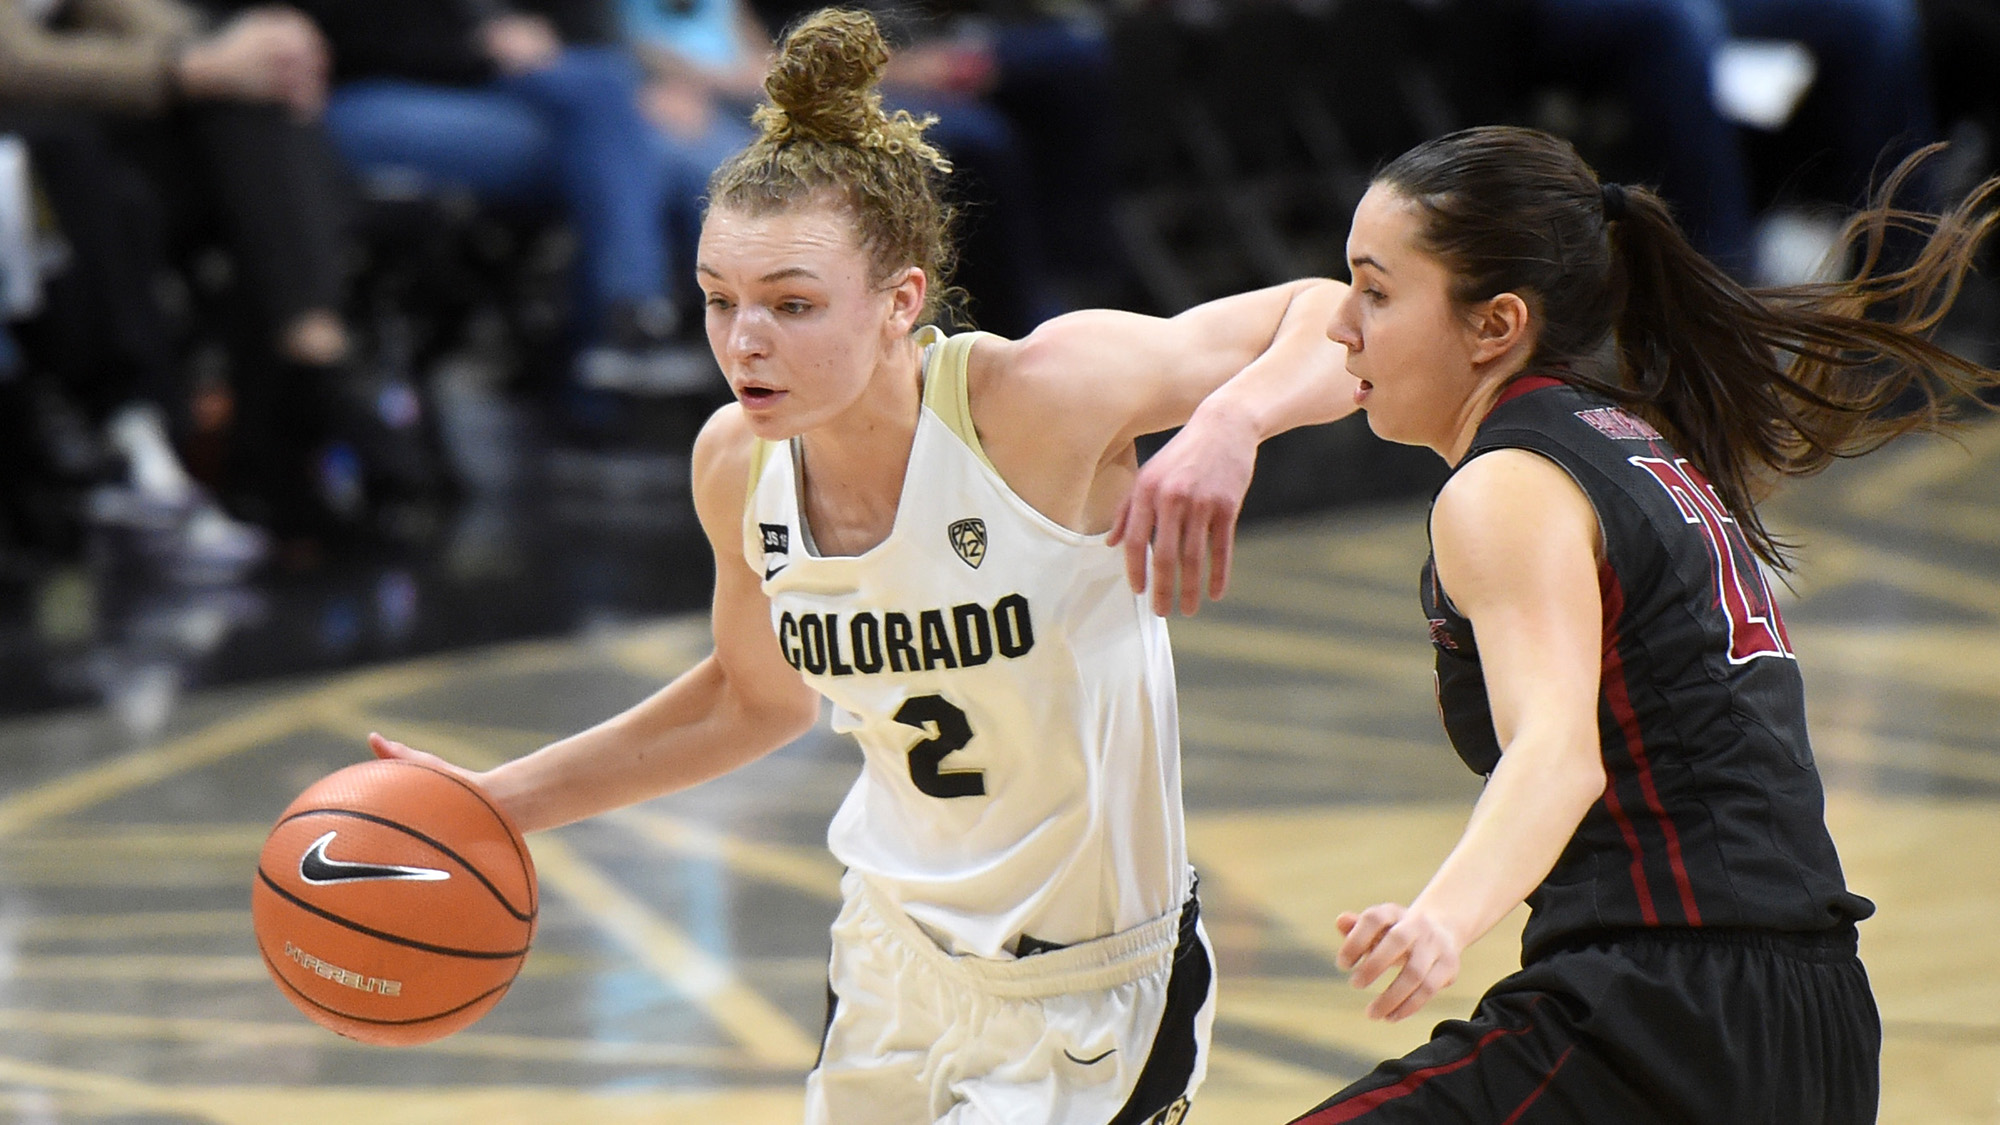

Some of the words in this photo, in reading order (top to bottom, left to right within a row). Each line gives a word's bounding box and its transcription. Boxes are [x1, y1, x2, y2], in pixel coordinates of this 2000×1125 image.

[766, 530, 779, 546] JS
[951, 521, 986, 550] PAC
[961, 539, 981, 558] 12
[779, 593, 1035, 676] COLORADO
[892, 694, 987, 799] 2
